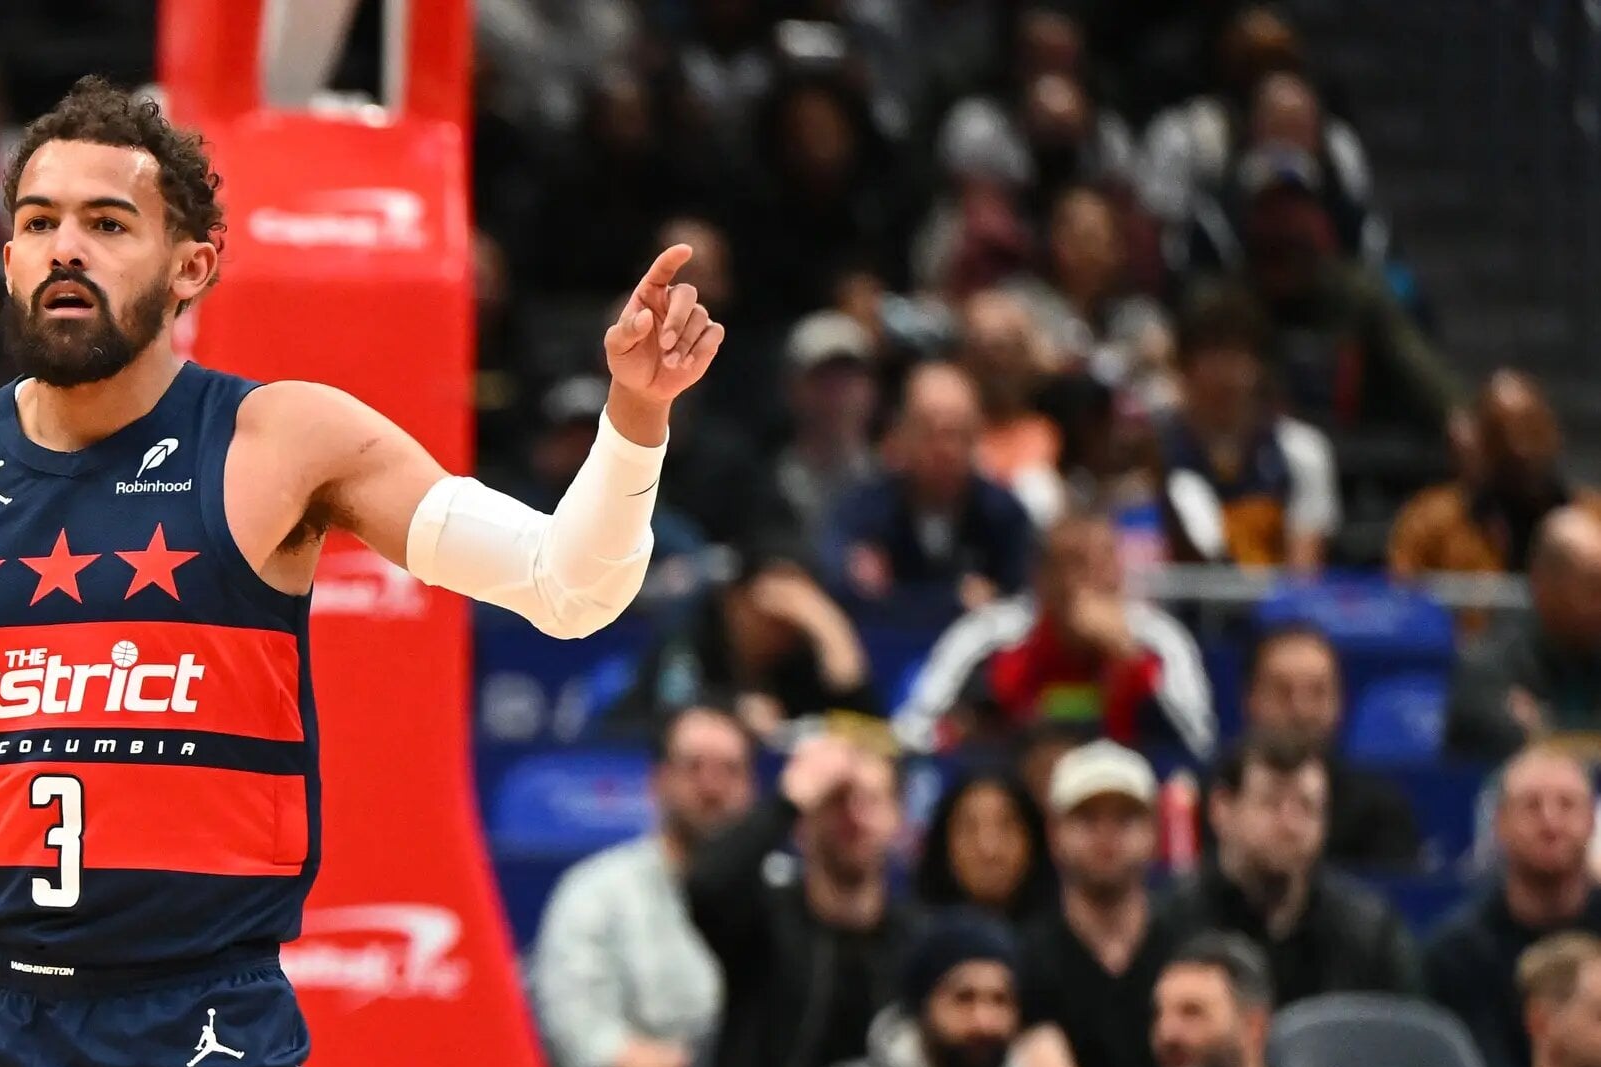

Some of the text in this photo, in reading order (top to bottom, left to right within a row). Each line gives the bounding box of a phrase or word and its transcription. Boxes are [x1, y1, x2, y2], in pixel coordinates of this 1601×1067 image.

[115, 478, 192, 494] Robinhood
[4, 647, 48, 668] THE
[28, 772, 85, 909] 3
[10, 960, 75, 976] WASHINGTON
